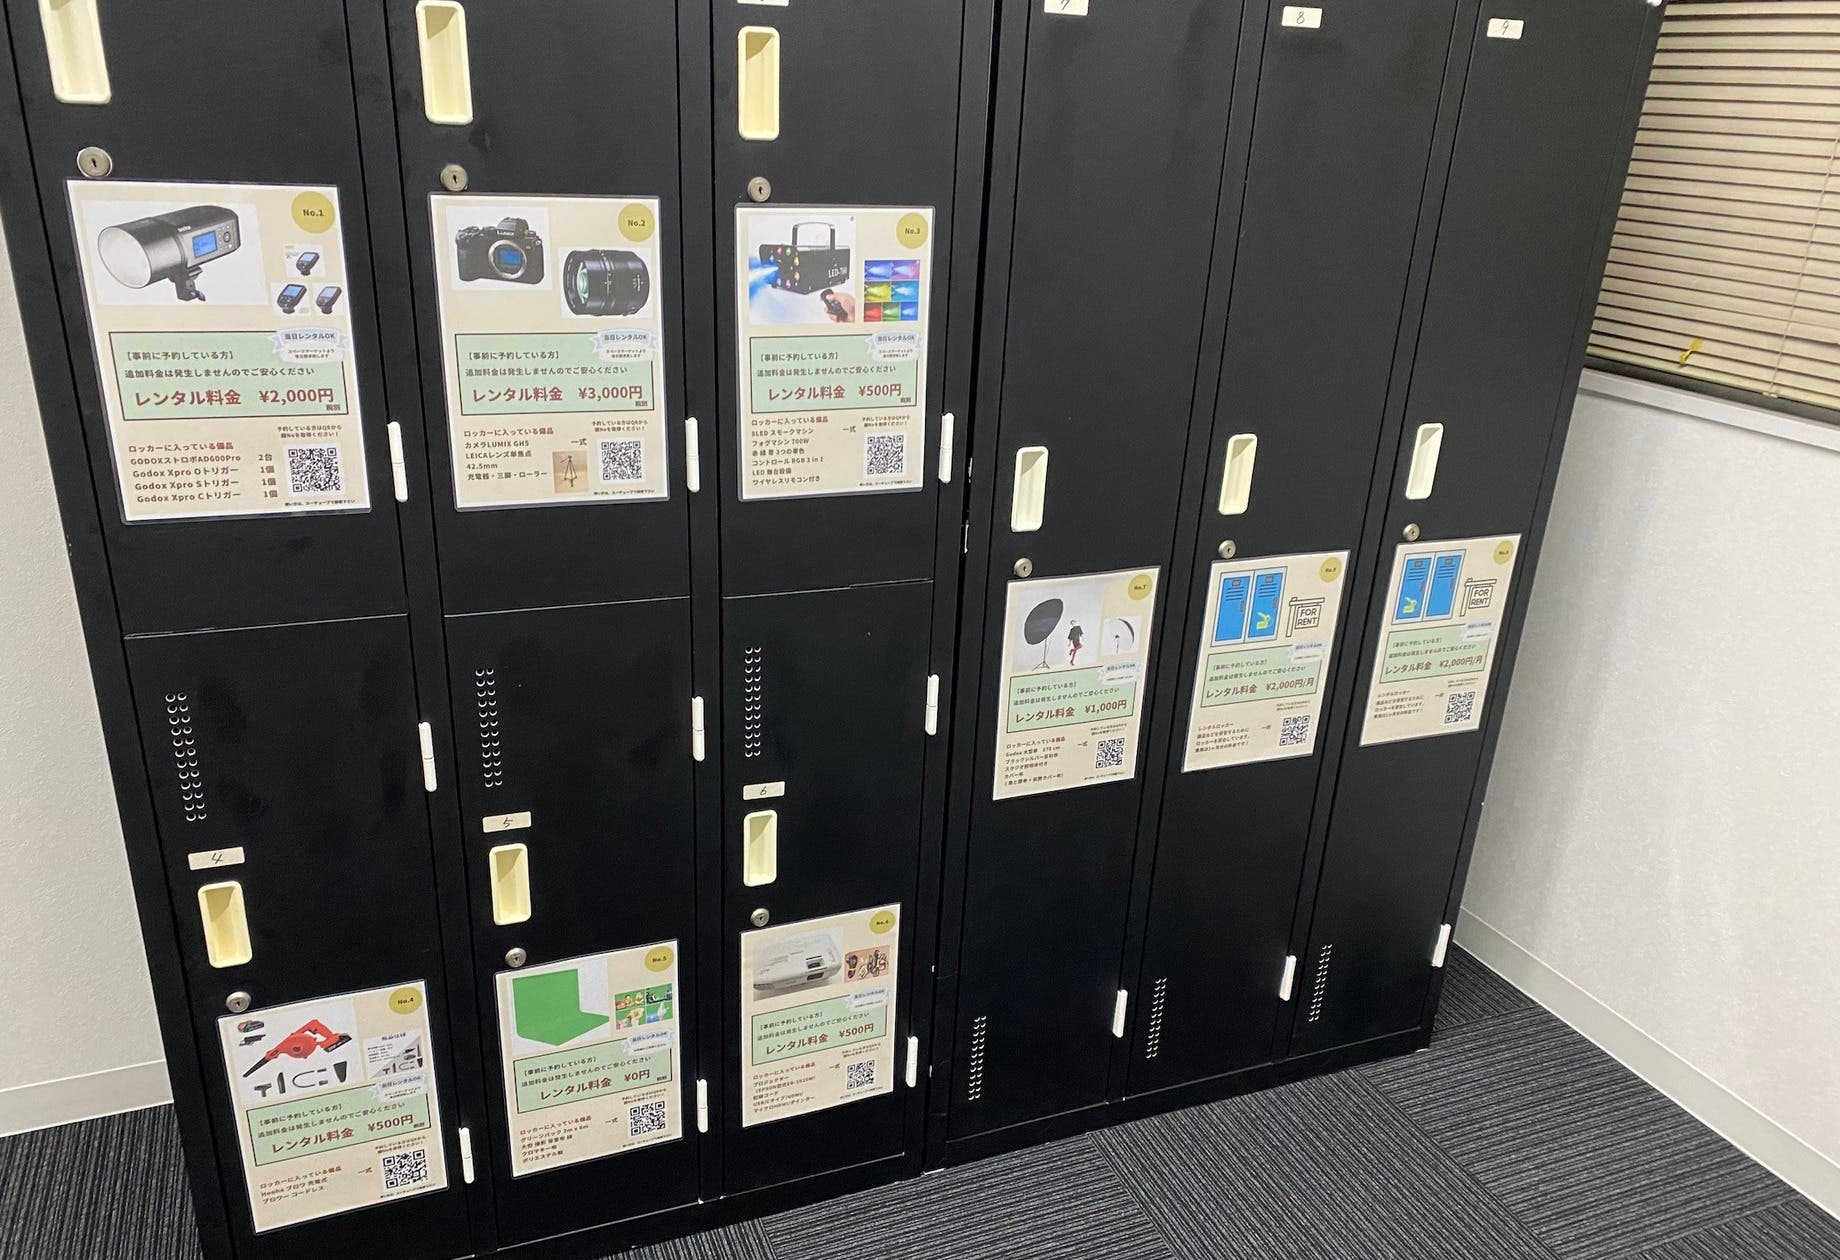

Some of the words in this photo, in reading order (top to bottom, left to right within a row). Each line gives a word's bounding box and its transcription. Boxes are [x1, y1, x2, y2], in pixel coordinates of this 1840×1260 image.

[1296, 11, 1305, 24] 8
[1502, 21, 1510, 35] 9
[302, 208, 325, 217] No.1
[627, 219, 646, 227] No.2
[904, 227, 921, 235] No.3
[284, 332, 336, 340] 当日レンタルOK
[125, 367, 315, 379] 追加料金は発生しませんのでご安心ください
[465, 366, 628, 377] 追加料金は発生しませんのでご安心ください
[757, 366, 896, 378] 追加料金は発生しませんのでご安心ください
[135, 389, 242, 407] レンタル料金
[259, 388, 334, 406] ¥2,000円
[473, 386, 563, 402] レンタル料金
[578, 385, 643, 401] ¥3,000円
[769, 385, 846, 401] レンタル料金
[858, 384, 902, 398] ¥500円
[751, 416, 828, 426] ロッカーに入っている備品
[463, 427, 554, 437] ロッカーに入っている備品
[770, 427, 814, 437] スモークマシン
[128, 442, 234, 453] ロッカーに入っている備品
[570, 438, 587, 446] 一式
[257, 453, 273, 462] 2台
[752, 458, 789, 467] コントロール
[132, 470, 166, 479] Godox
[167, 469, 192, 478] Xpro
[260, 466, 275, 474] 1個
[134, 482, 168, 491] Godox
[170, 481, 194, 490] Xpro
[262, 478, 277, 486] 1個
[752, 475, 821, 486] ワイヤレスリモコン付き
[137, 495, 170, 504] Godox
[171, 493, 195, 502] Xpro
[263, 490, 278, 499] 1個
[1474, 588, 1489, 597] FOR
[1470, 597, 1489, 606] RENT
[1300, 608, 1317, 617] FOR
[1297, 617, 1318, 626] RENT
[1385, 661, 1432, 675] レンタル料金
[1206, 684, 1258, 699] レンタル料金
[1266, 678, 1315, 692] ¥2,000円/月
[1016, 706, 1075, 723] レンタル料金
[1085, 700, 1127, 714] ¥1,000円
[760, 785, 767, 796] 6
[503, 817, 514, 828] 5
[211, 852, 223, 865] 4
[766, 1034, 829, 1055] レンタル料金
[839, 1023, 874, 1039] ¥500円
[540, 1077, 612, 1101] レンタル料金
[623, 1069, 650, 1083] ¥0円
[271, 1127, 355, 1154] レンタル料金
[367, 1114, 414, 1132] ¥500円
[260, 1165, 342, 1189] ロッカーに入っている備品
